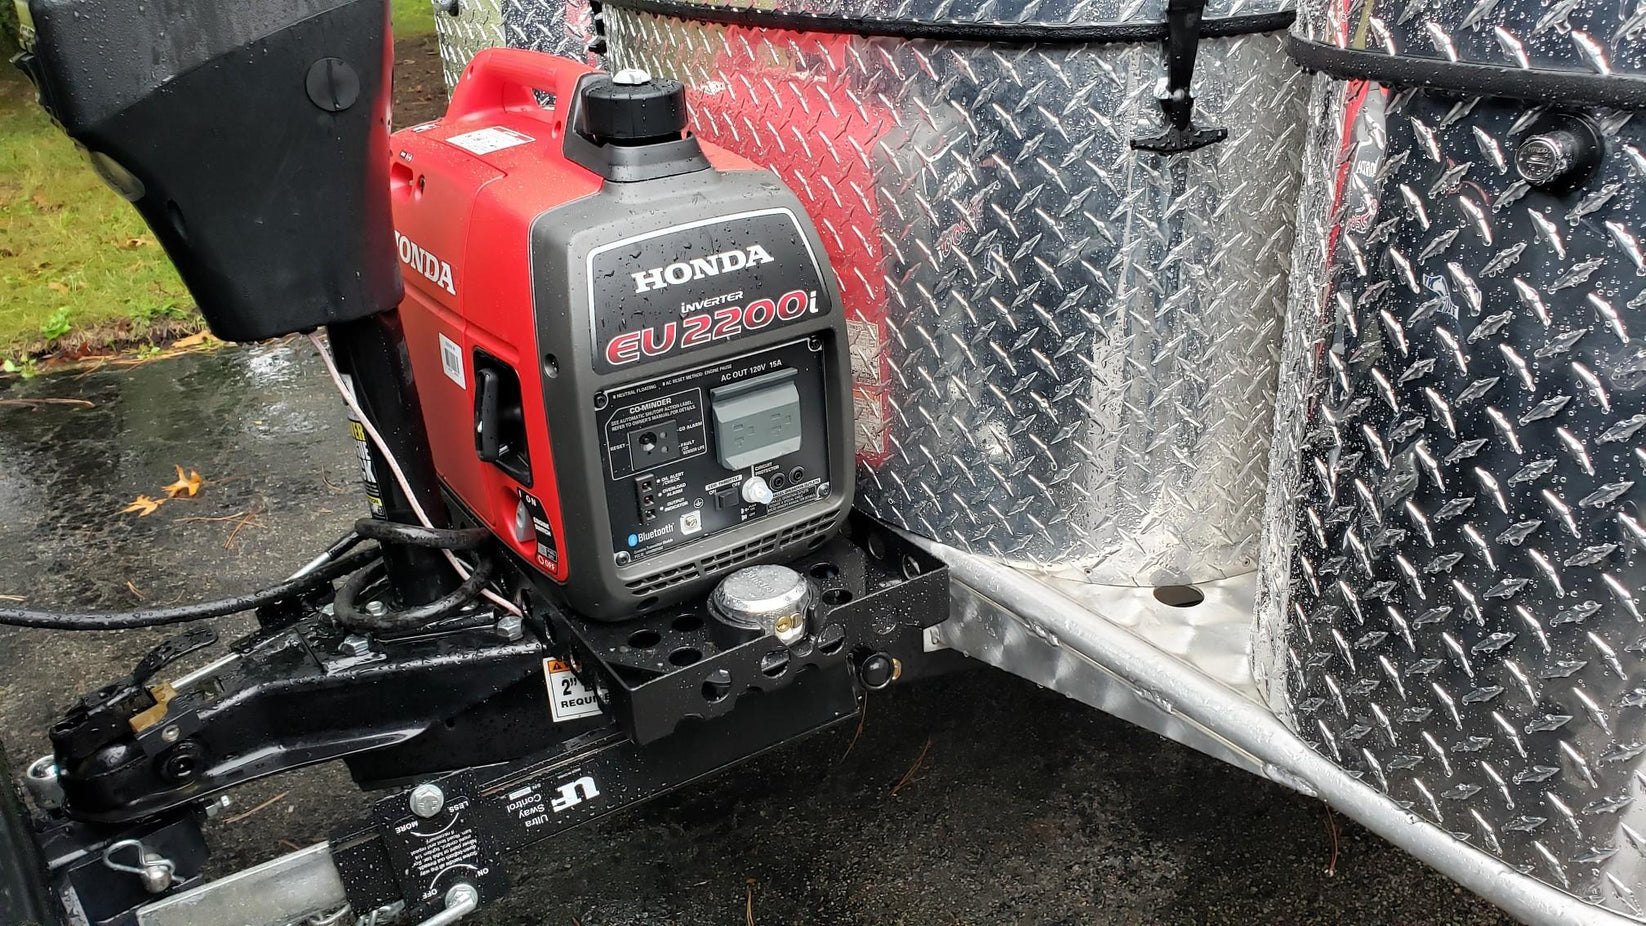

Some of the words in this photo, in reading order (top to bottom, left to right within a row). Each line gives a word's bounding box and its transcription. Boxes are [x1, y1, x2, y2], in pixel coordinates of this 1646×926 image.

[631, 244, 775, 293] HONDA
[720, 372, 731, 382] AC
[732, 368, 748, 379] OUT
[749, 363, 767, 374] 120V
[769, 359, 782, 369] 15A
[636, 384, 657, 393] FLOATING
[629, 397, 672, 414] CO-MINDER
[686, 421, 703, 430] ALARM
[669, 471, 685, 480] ALERT
[662, 482, 687, 494] OVERLOAD
[666, 488, 683, 497] ALARM
[526, 494, 537, 507] ON
[638, 524, 674, 543] Bluetooth
[448, 801, 469, 813] LESS
[506, 793, 542, 813] Control
[518, 804, 545, 819] Sway
[395, 820, 419, 834] MORE
[525, 814, 549, 828] Ultra
[477, 867, 489, 877] ON
[422, 888, 438, 900] OFF
